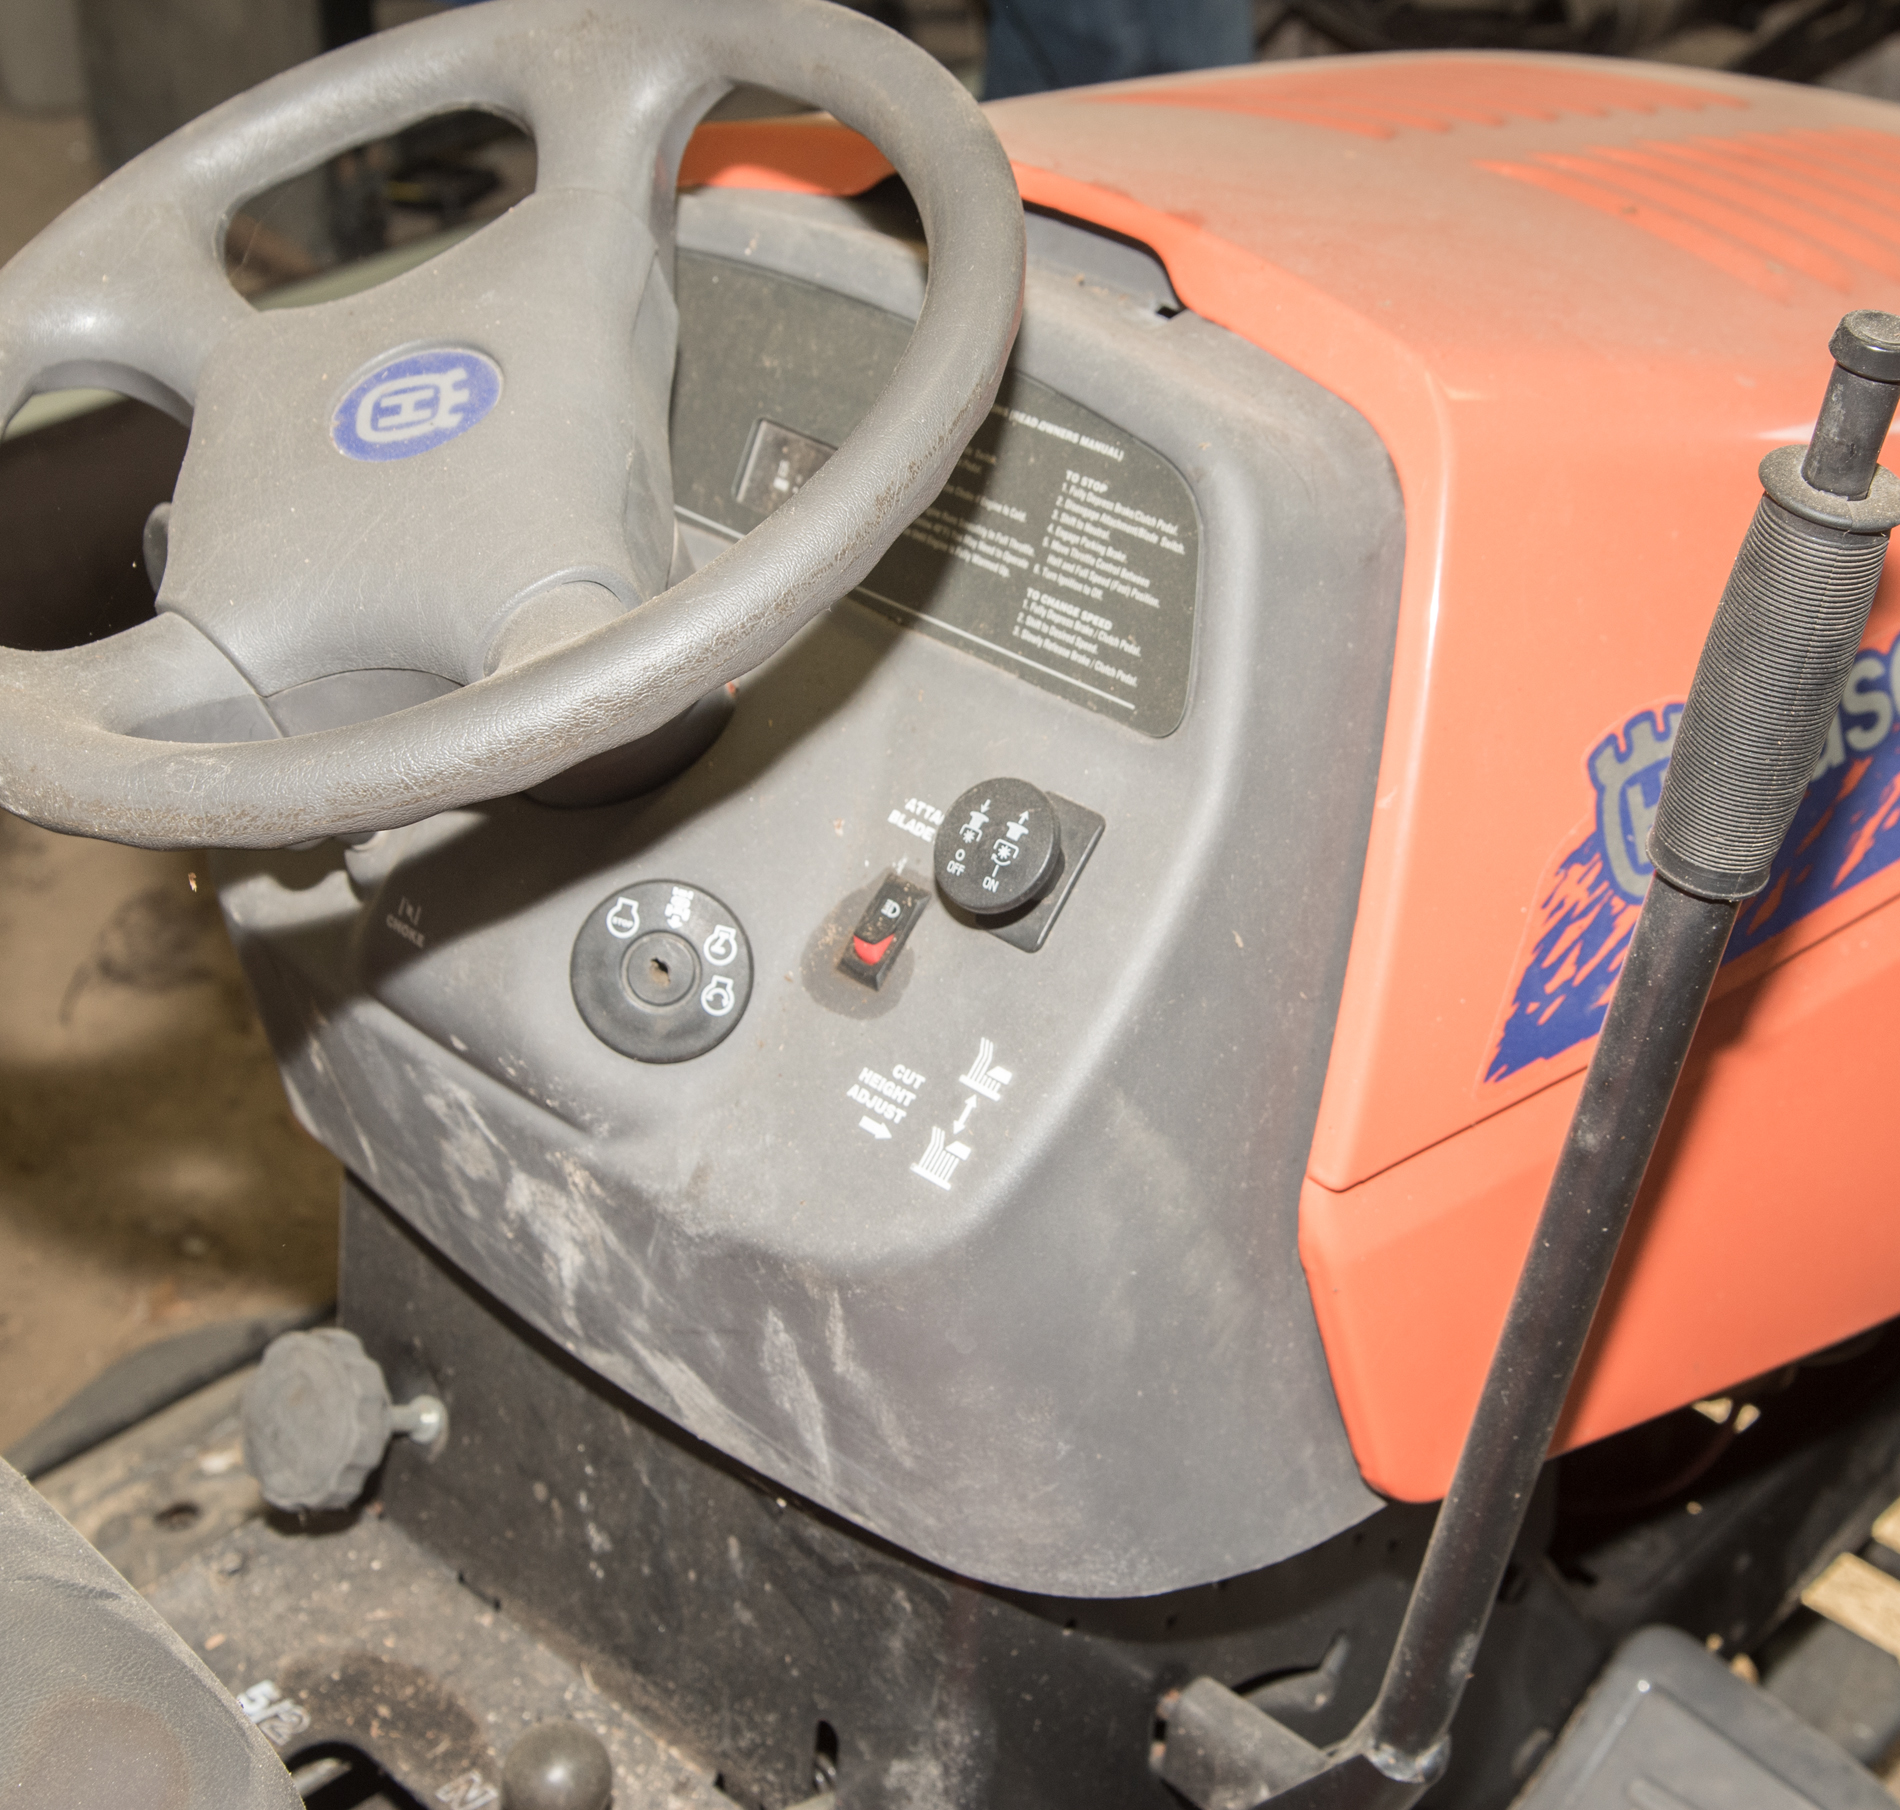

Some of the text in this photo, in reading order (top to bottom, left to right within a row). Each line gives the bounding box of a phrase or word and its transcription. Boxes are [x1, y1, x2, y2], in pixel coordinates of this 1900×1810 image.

[1038, 420, 1080, 444] OWNERS
[1079, 435, 1124, 462] MANUAL)
[1066, 470, 1108, 493] TO STOP
[1069, 485, 1086, 502] Fully
[1086, 491, 1114, 511] Depress
[1060, 512, 1077, 527] Shift
[1080, 536, 1106, 556] Parking
[1042, 567, 1058, 581] Turn
[1062, 561, 1076, 573] and
[1089, 571, 1111, 589] Speed
[1096, 558, 1121, 576] Control
[1027, 587, 1112, 631] TO CHANGE SPEED
[1025, 615, 1042, 630] Shift
[1049, 625, 1075, 645] Desired
[1030, 602, 1047, 618] Fully
[1047, 609, 1074, 628] Depress
[1074, 620, 1094, 637] Brake
[1098, 630, 1119, 648] Clutch
[1021, 629, 1043, 648] Slowly
[1043, 638, 1071, 658] Release
[1070, 650, 1091, 667] Brake
[1094, 660, 1116, 678] Clutch
[904, 797, 945, 826] ATTA
[947, 860, 966, 877] OFF
[982, 876, 999, 893] ON
[386, 914, 425, 948] CHOKE
[612, 916, 634, 929] STOP
[858, 1066, 917, 1107] HEIGHT
[892, 1064, 926, 1090] CUT
[846, 1083, 907, 1124] ADJUST
